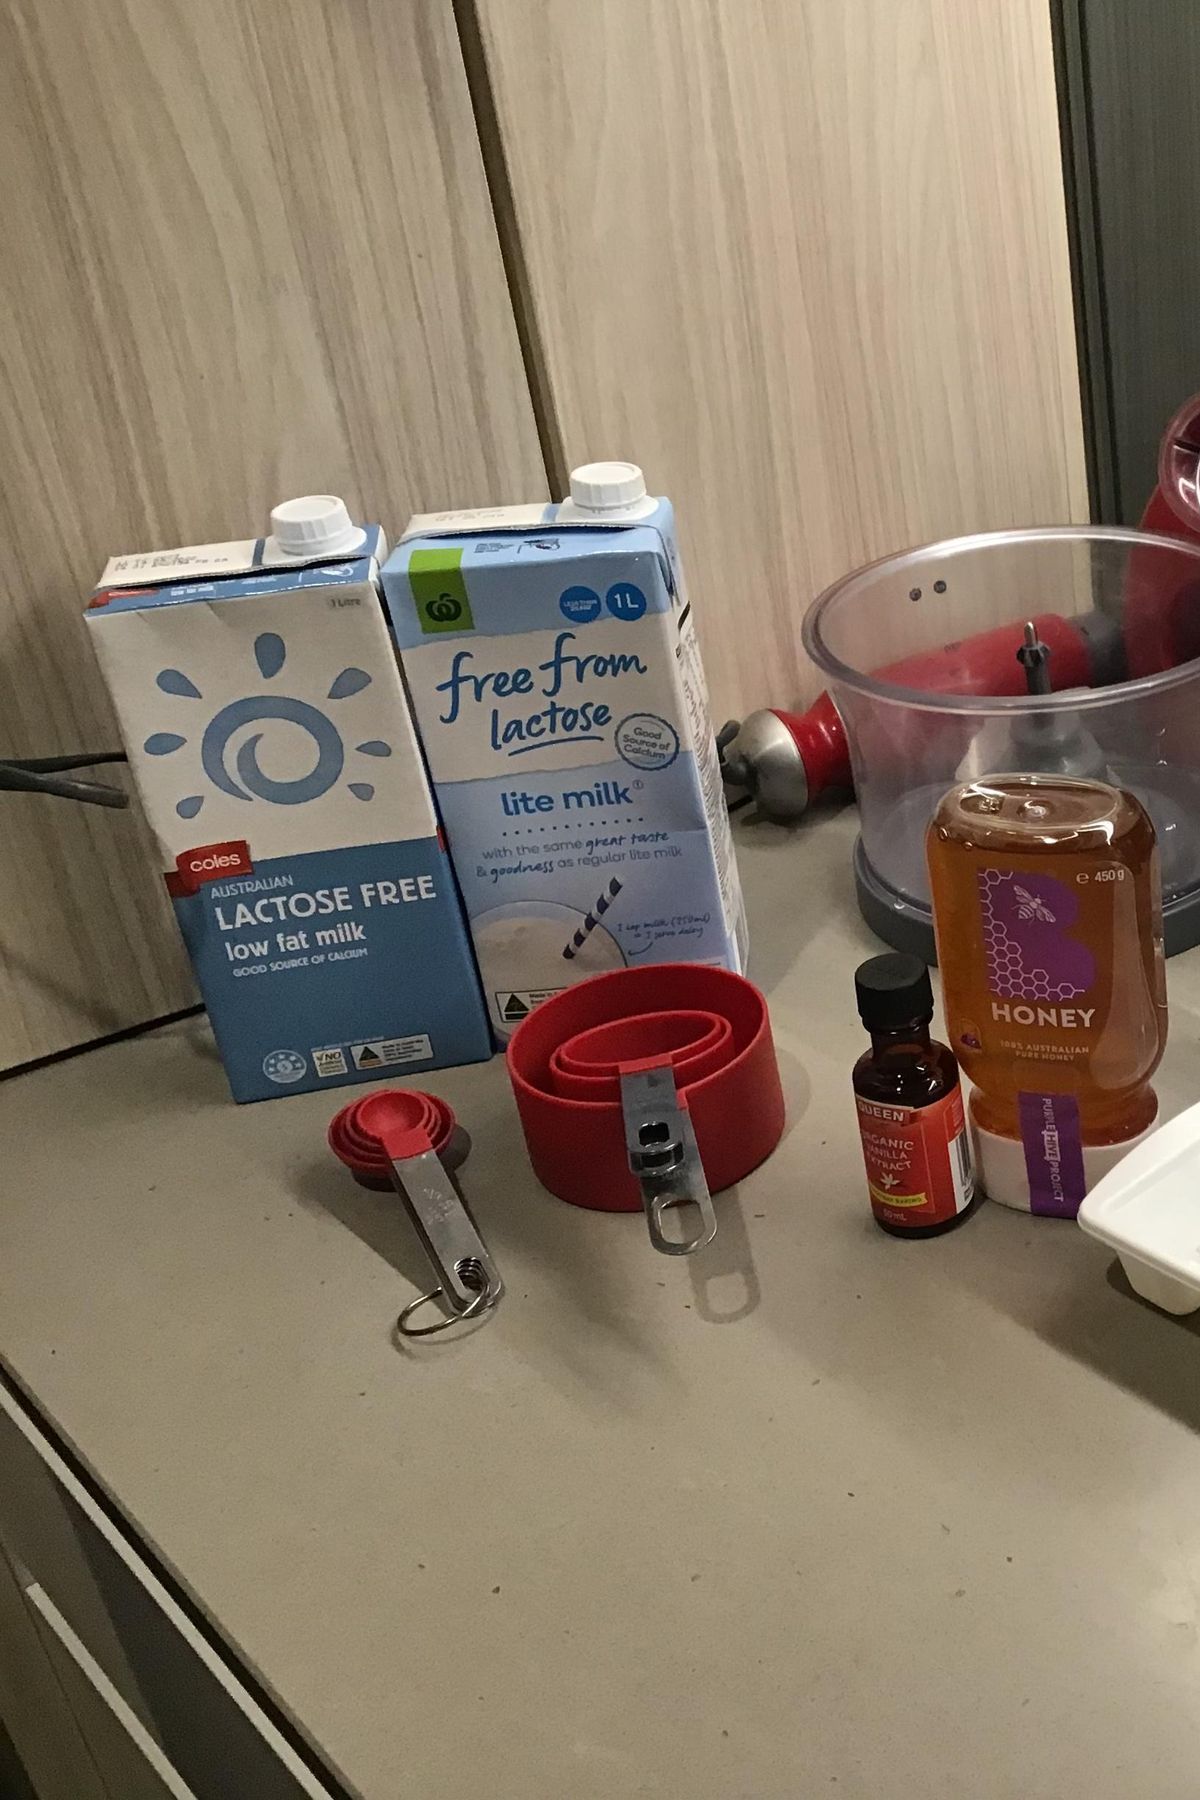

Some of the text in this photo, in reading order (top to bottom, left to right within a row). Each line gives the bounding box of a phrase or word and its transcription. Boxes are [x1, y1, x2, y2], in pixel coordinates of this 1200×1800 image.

[436, 651, 534, 724] free
[538, 632, 648, 697] from
[491, 701, 613, 750] lactose
[634, 727, 662, 740] Good
[623, 734, 671, 751] Source of
[623, 744, 666, 759] Calcium
[500, 781, 633, 817] lite milk
[483, 831, 670, 860] with the same great taste
[190, 853, 241, 872] coles
[476, 845, 682, 883] & goodness as regular lite milk
[211, 874, 294, 899] AUSTRALIAN
[215, 875, 437, 931] LACTOSE FREE
[225, 921, 367, 961] low fat milk
[233, 948, 368, 977] GOOD SOURCE OF CALCIUM
[991, 1003, 1095, 1028] HONEY
[1016, 1050, 1039, 1059] PURE
[1026, 1044, 1089, 1054] AUSTRALIAN
